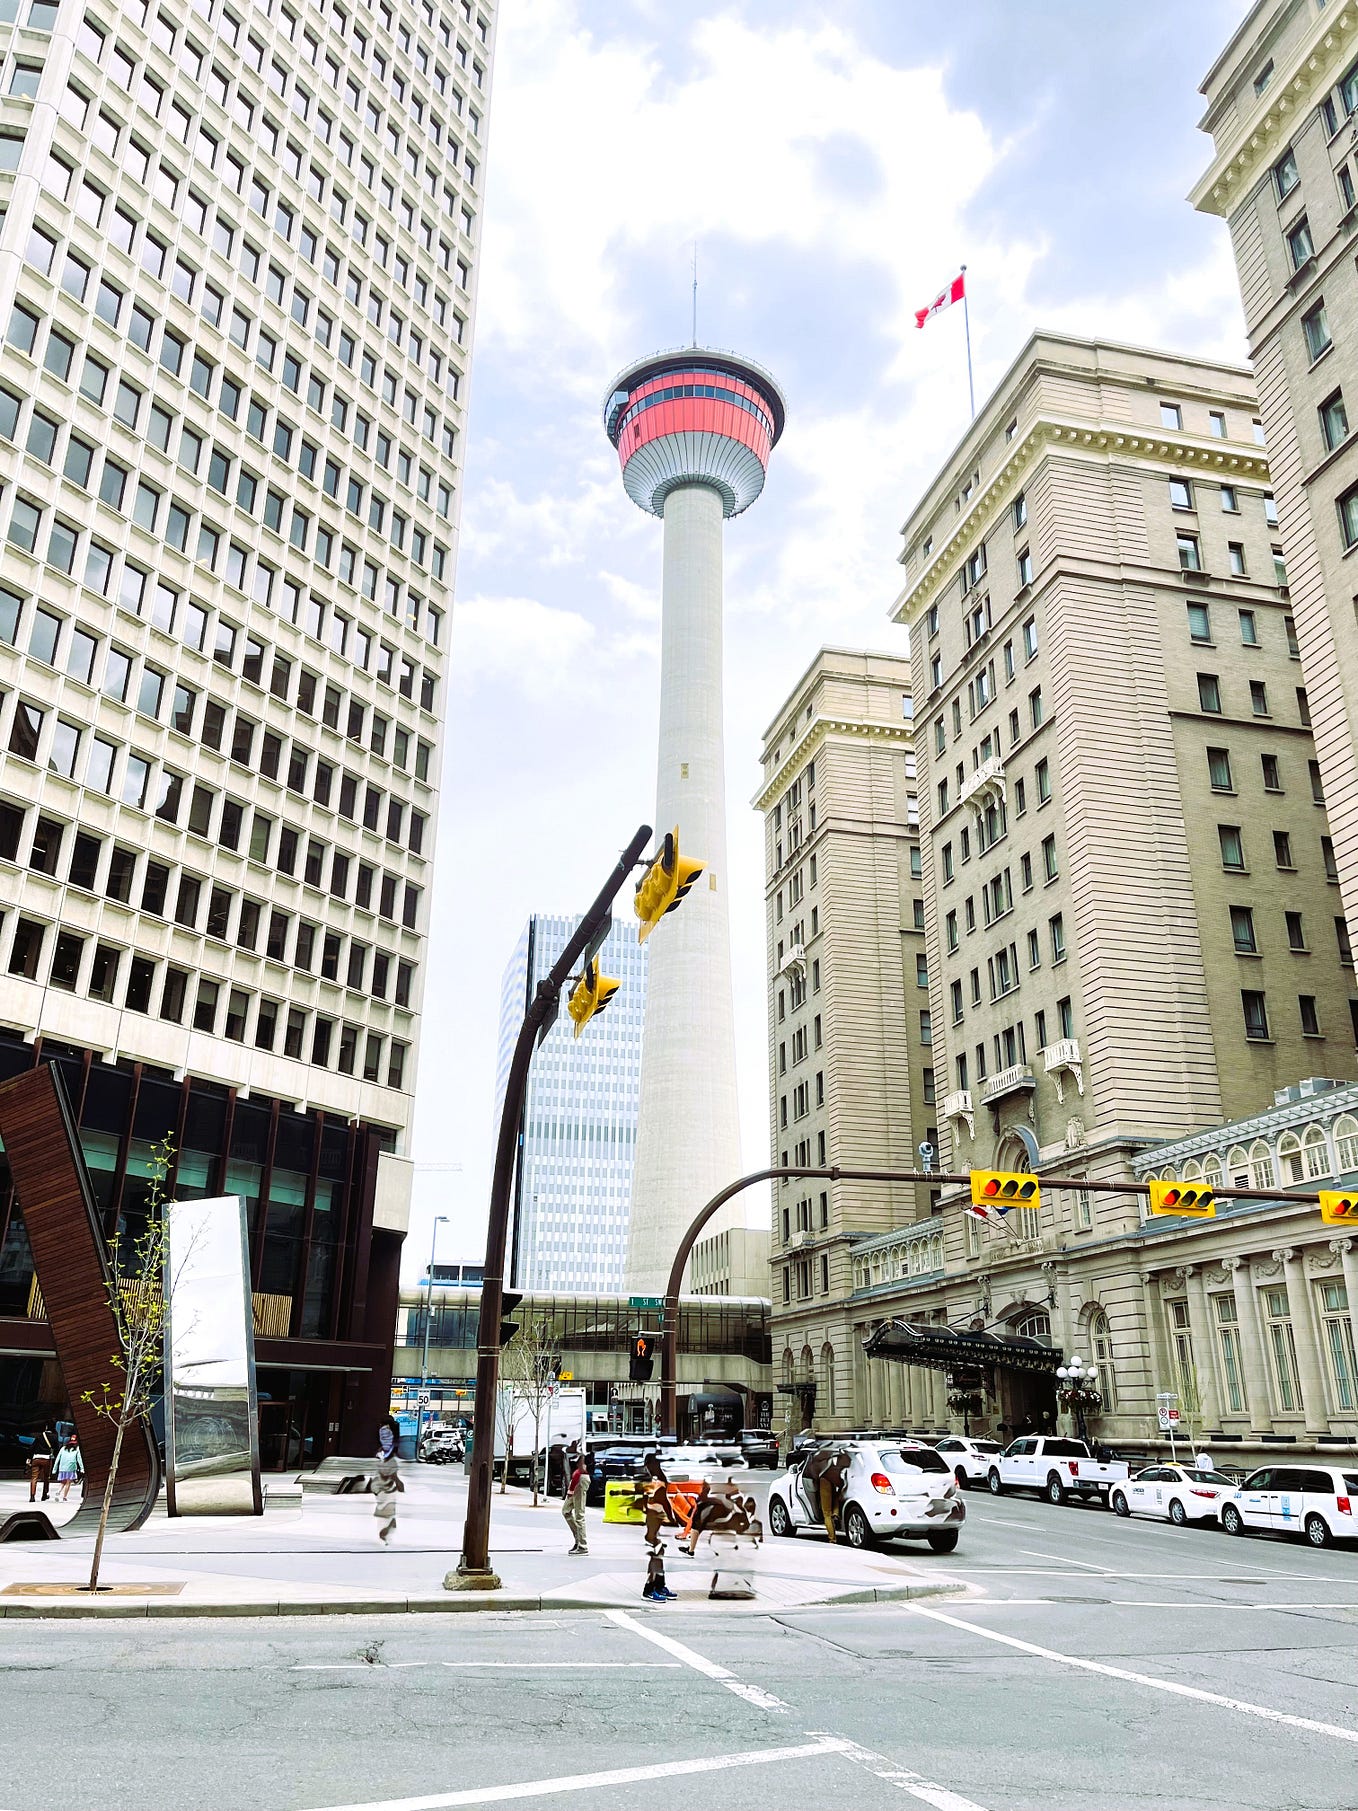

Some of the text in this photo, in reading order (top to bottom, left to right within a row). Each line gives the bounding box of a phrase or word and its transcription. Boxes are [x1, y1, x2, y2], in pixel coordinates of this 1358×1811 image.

[642, 1298, 649, 1306] ST
[655, 1298, 663, 1306] SW
[418, 1395, 428, 1404] 50
